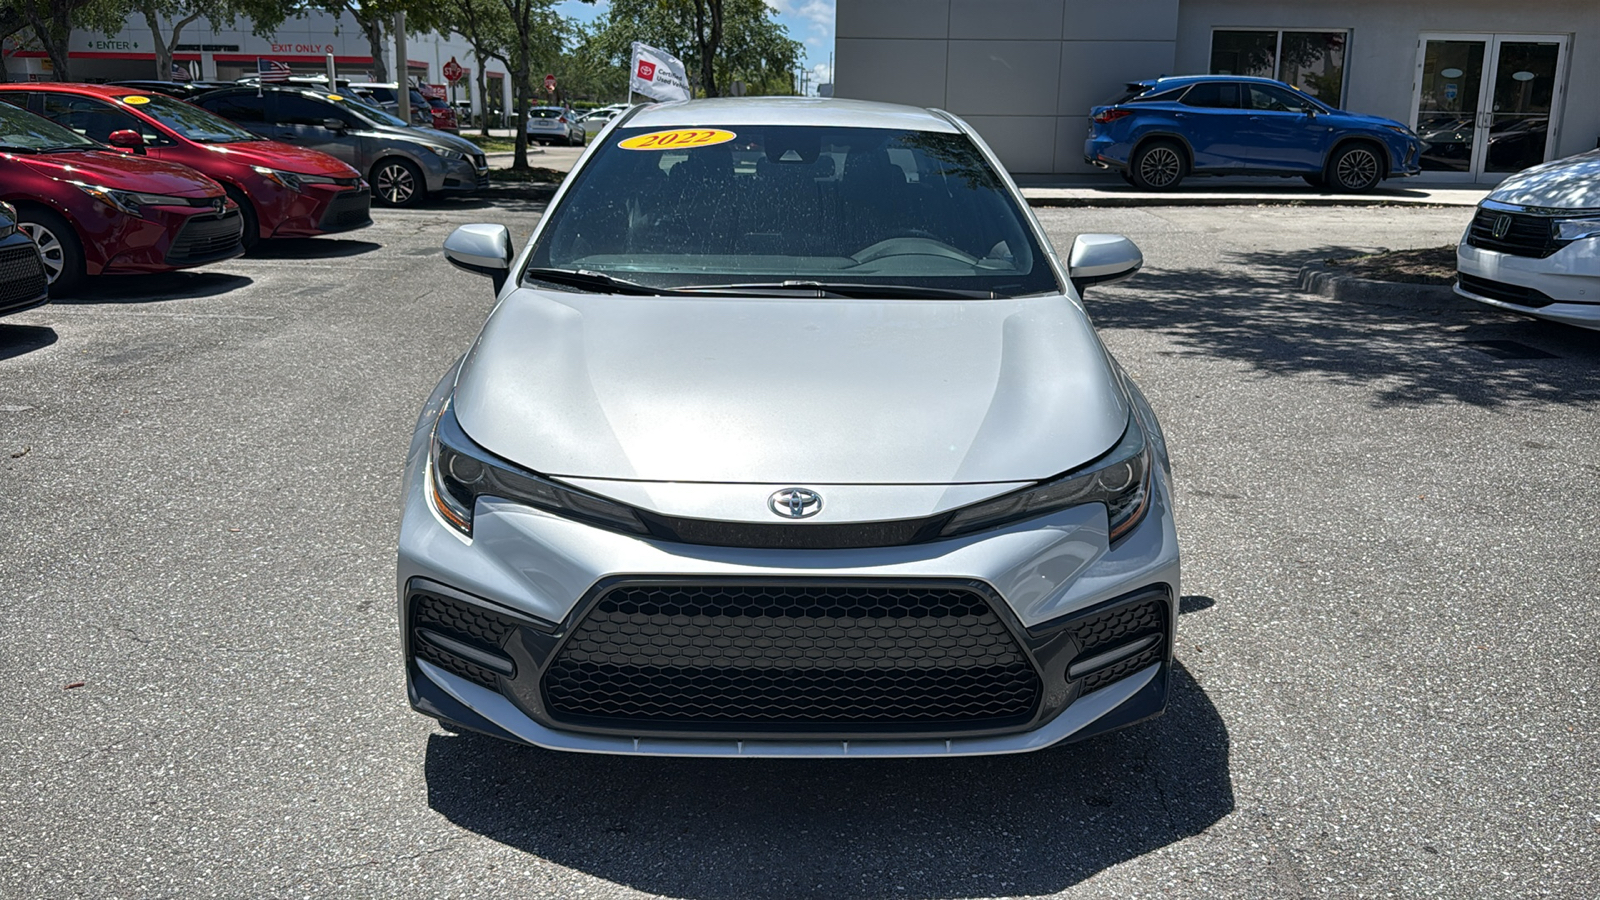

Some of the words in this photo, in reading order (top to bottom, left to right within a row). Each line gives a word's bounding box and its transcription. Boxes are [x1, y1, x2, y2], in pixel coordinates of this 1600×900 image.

[96, 41, 130, 50] ENTER
[272, 44, 293, 52] EXIT
[295, 44, 321, 53] ONLY
[444, 67, 461, 76] STP
[656, 76, 672, 85] Used
[636, 131, 716, 148] 2022
